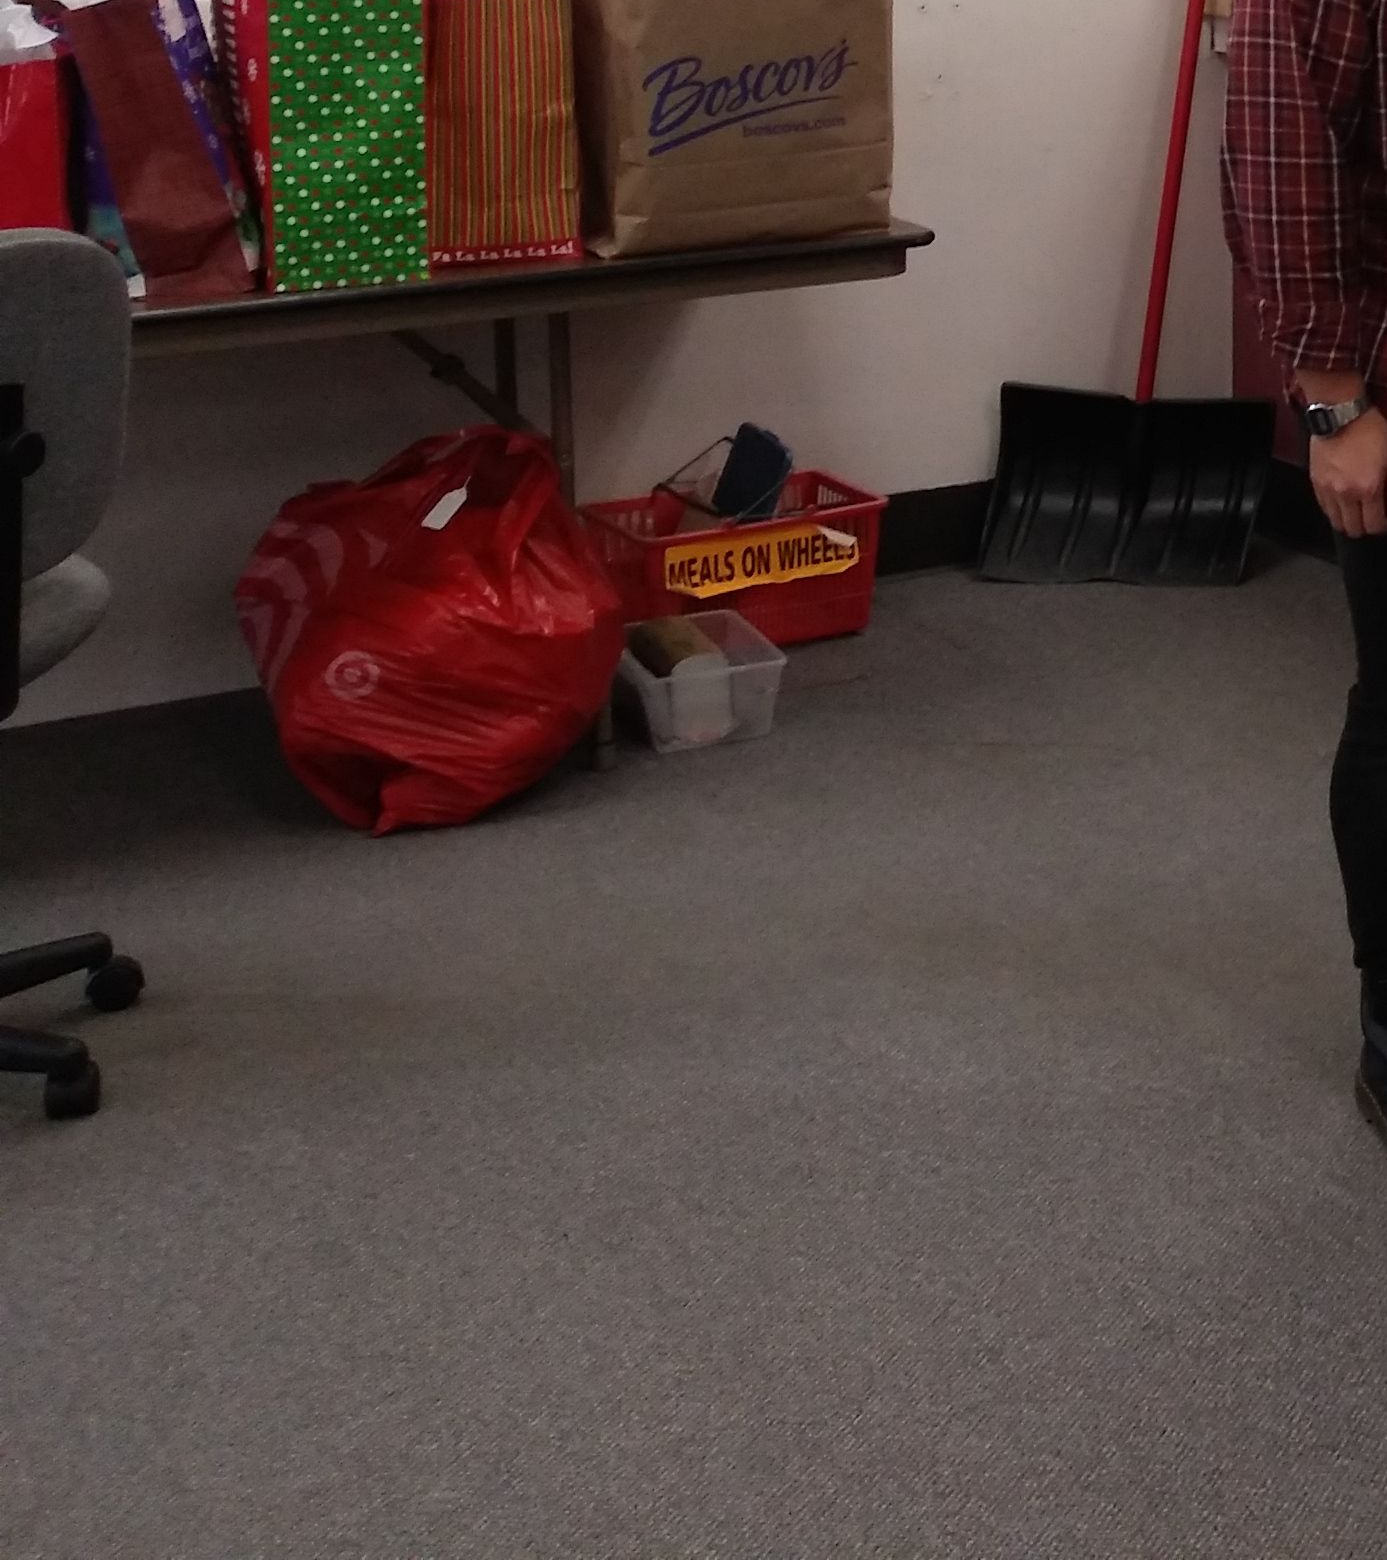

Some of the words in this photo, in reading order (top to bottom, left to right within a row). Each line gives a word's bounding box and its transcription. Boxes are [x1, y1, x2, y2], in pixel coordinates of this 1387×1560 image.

[642, 38, 858, 137] Boscov's
[455, 251, 475, 261] La
[480, 250, 499, 260] La
[503, 248, 522, 258] La
[527, 246, 546, 257] La
[668, 550, 736, 588] MEALS
[742, 543, 772, 578] ON
